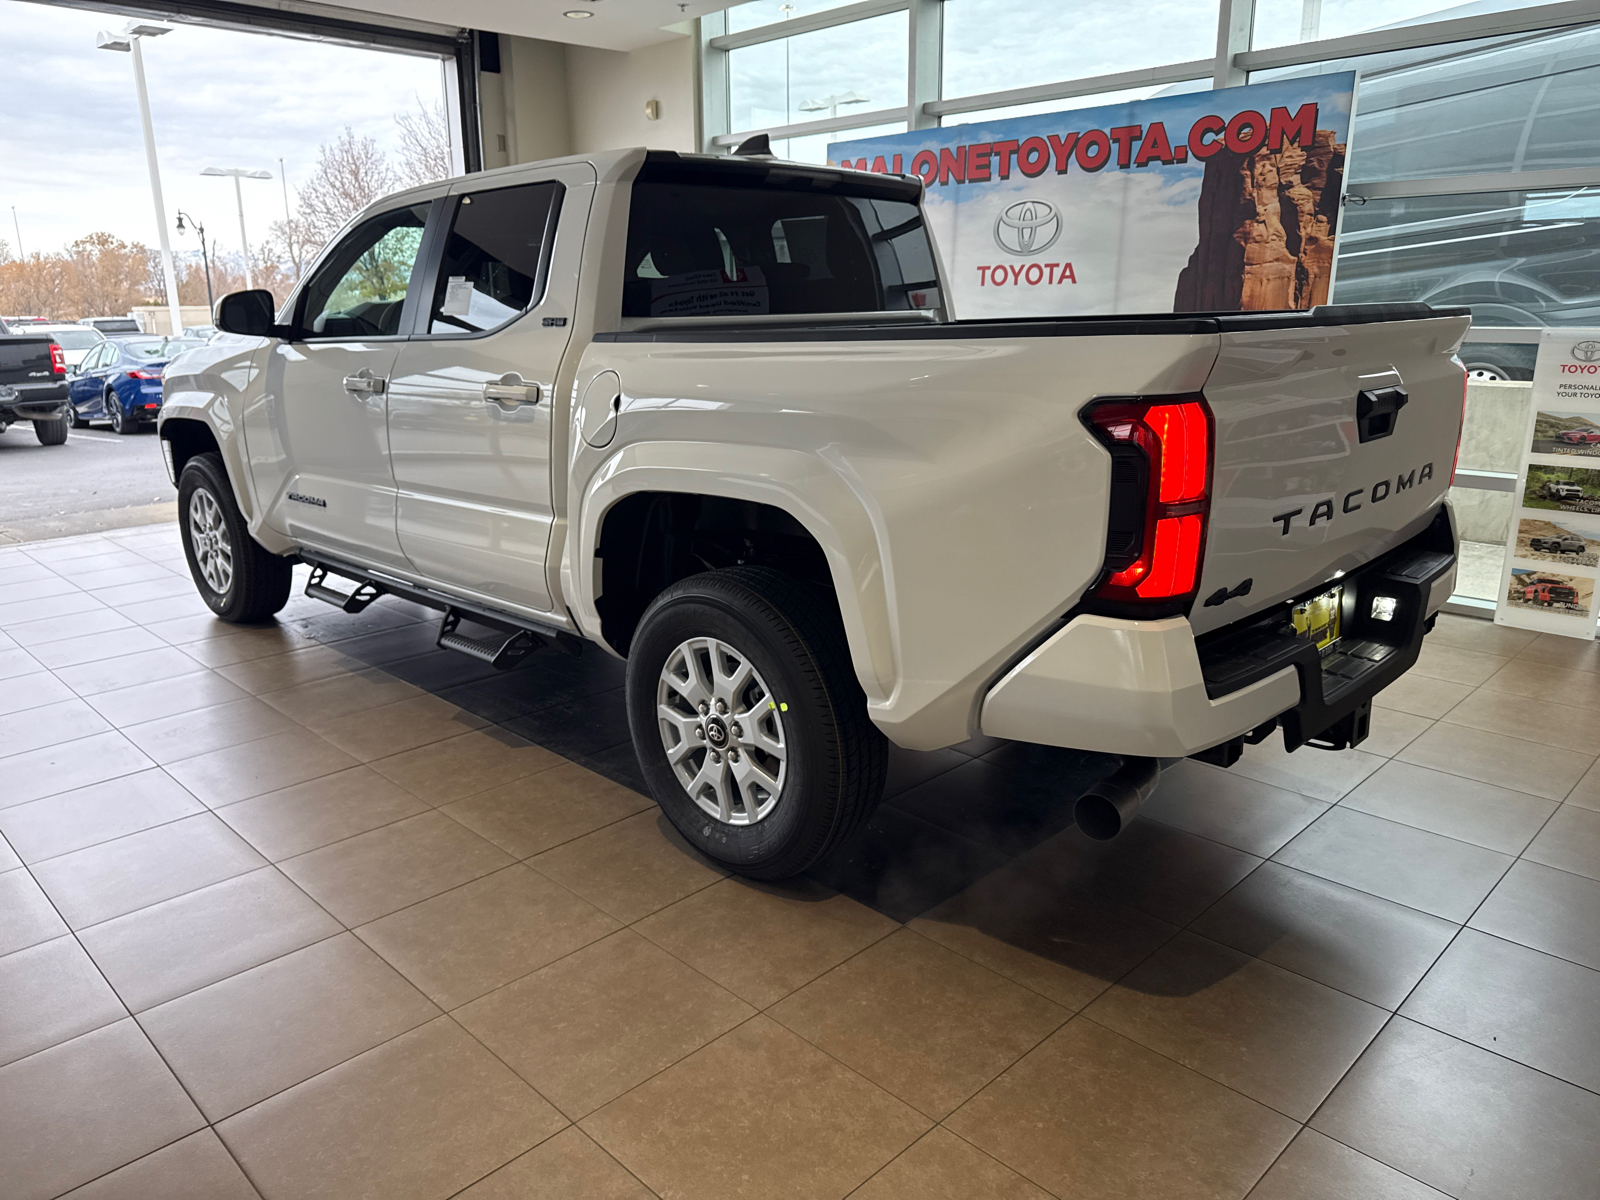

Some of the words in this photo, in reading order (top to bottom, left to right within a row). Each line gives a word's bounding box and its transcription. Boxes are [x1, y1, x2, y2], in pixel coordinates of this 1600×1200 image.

[841, 103, 1318, 188] ONETOYOTA.COM
[977, 262, 1077, 287] TOYOTA
[1273, 462, 1433, 536] TACOMA
